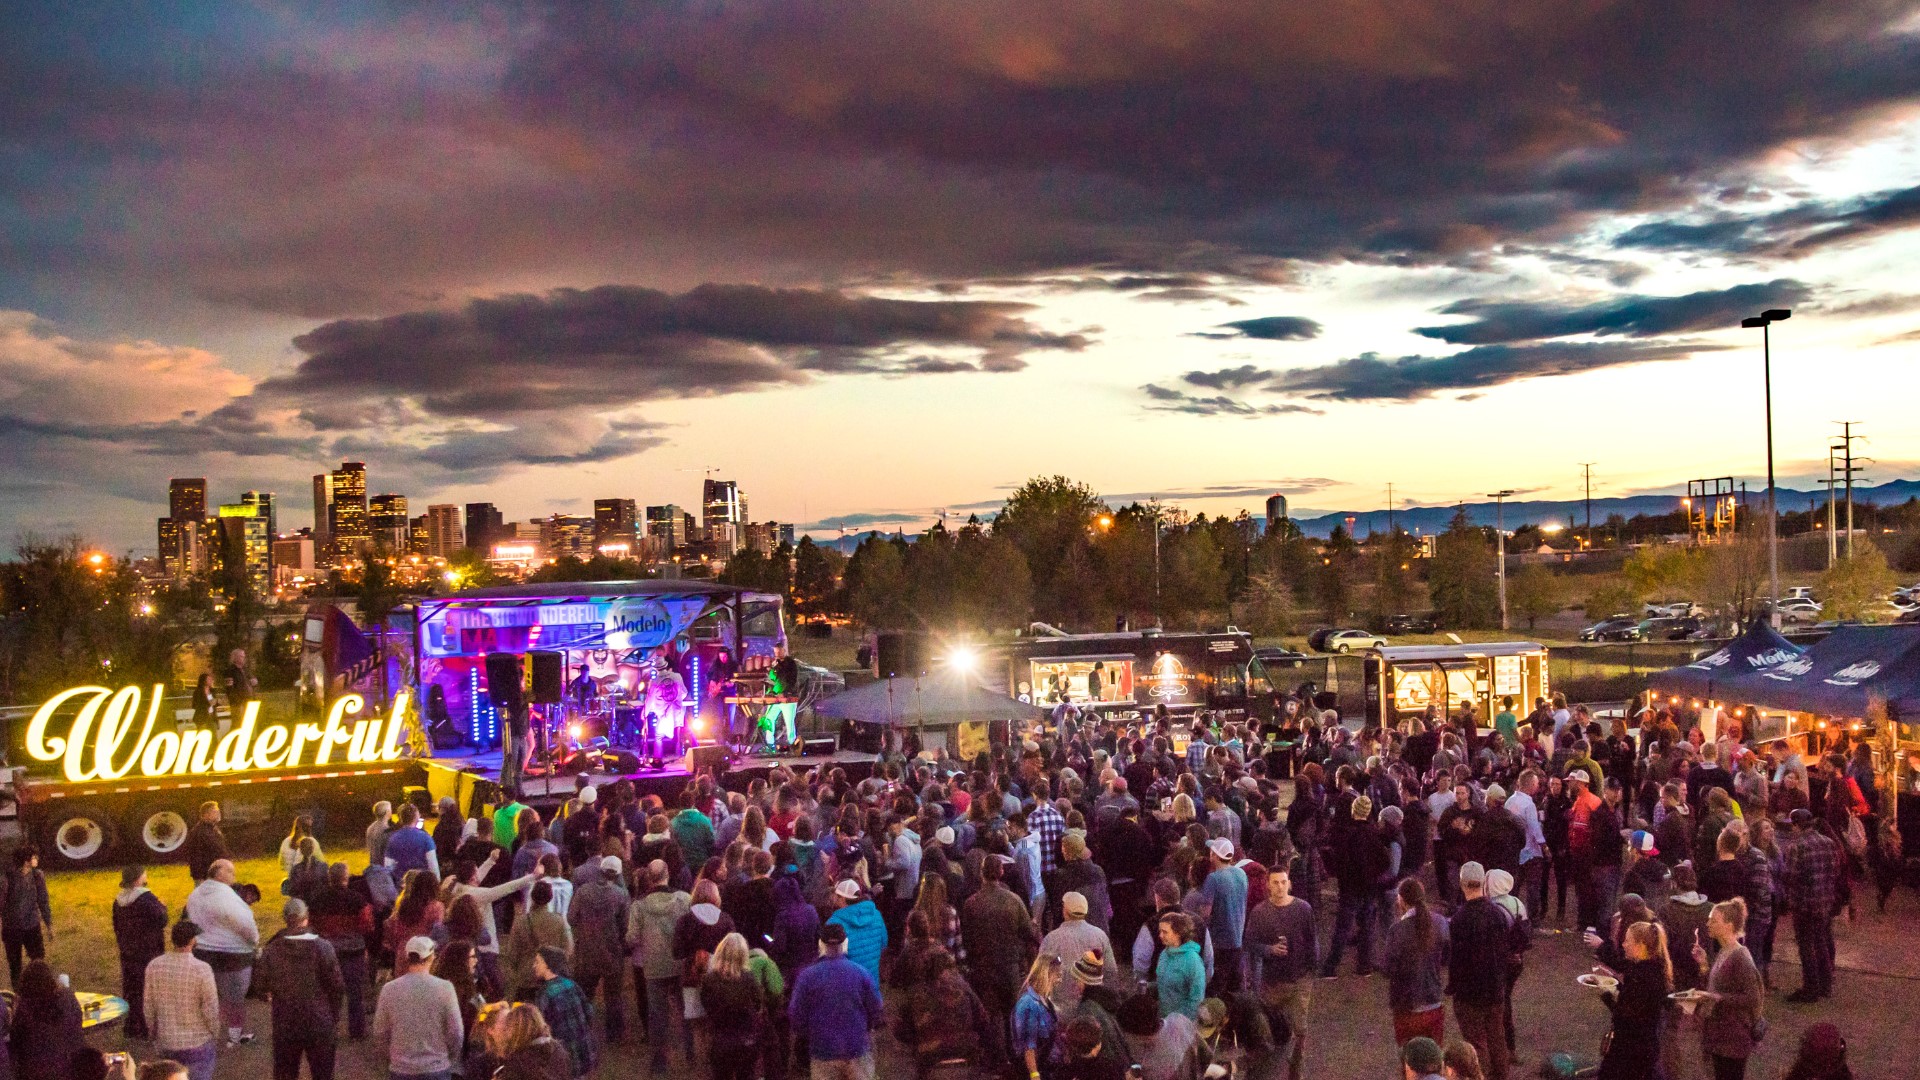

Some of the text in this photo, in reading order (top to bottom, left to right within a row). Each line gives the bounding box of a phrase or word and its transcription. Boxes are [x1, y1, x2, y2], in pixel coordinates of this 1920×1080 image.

[462, 611, 490, 628] THE
[513, 603, 600, 627] WONDERFUL
[613, 614, 666, 633] Modelo
[530, 624, 604, 648] TAGE
[26, 683, 410, 782] Wonderful
